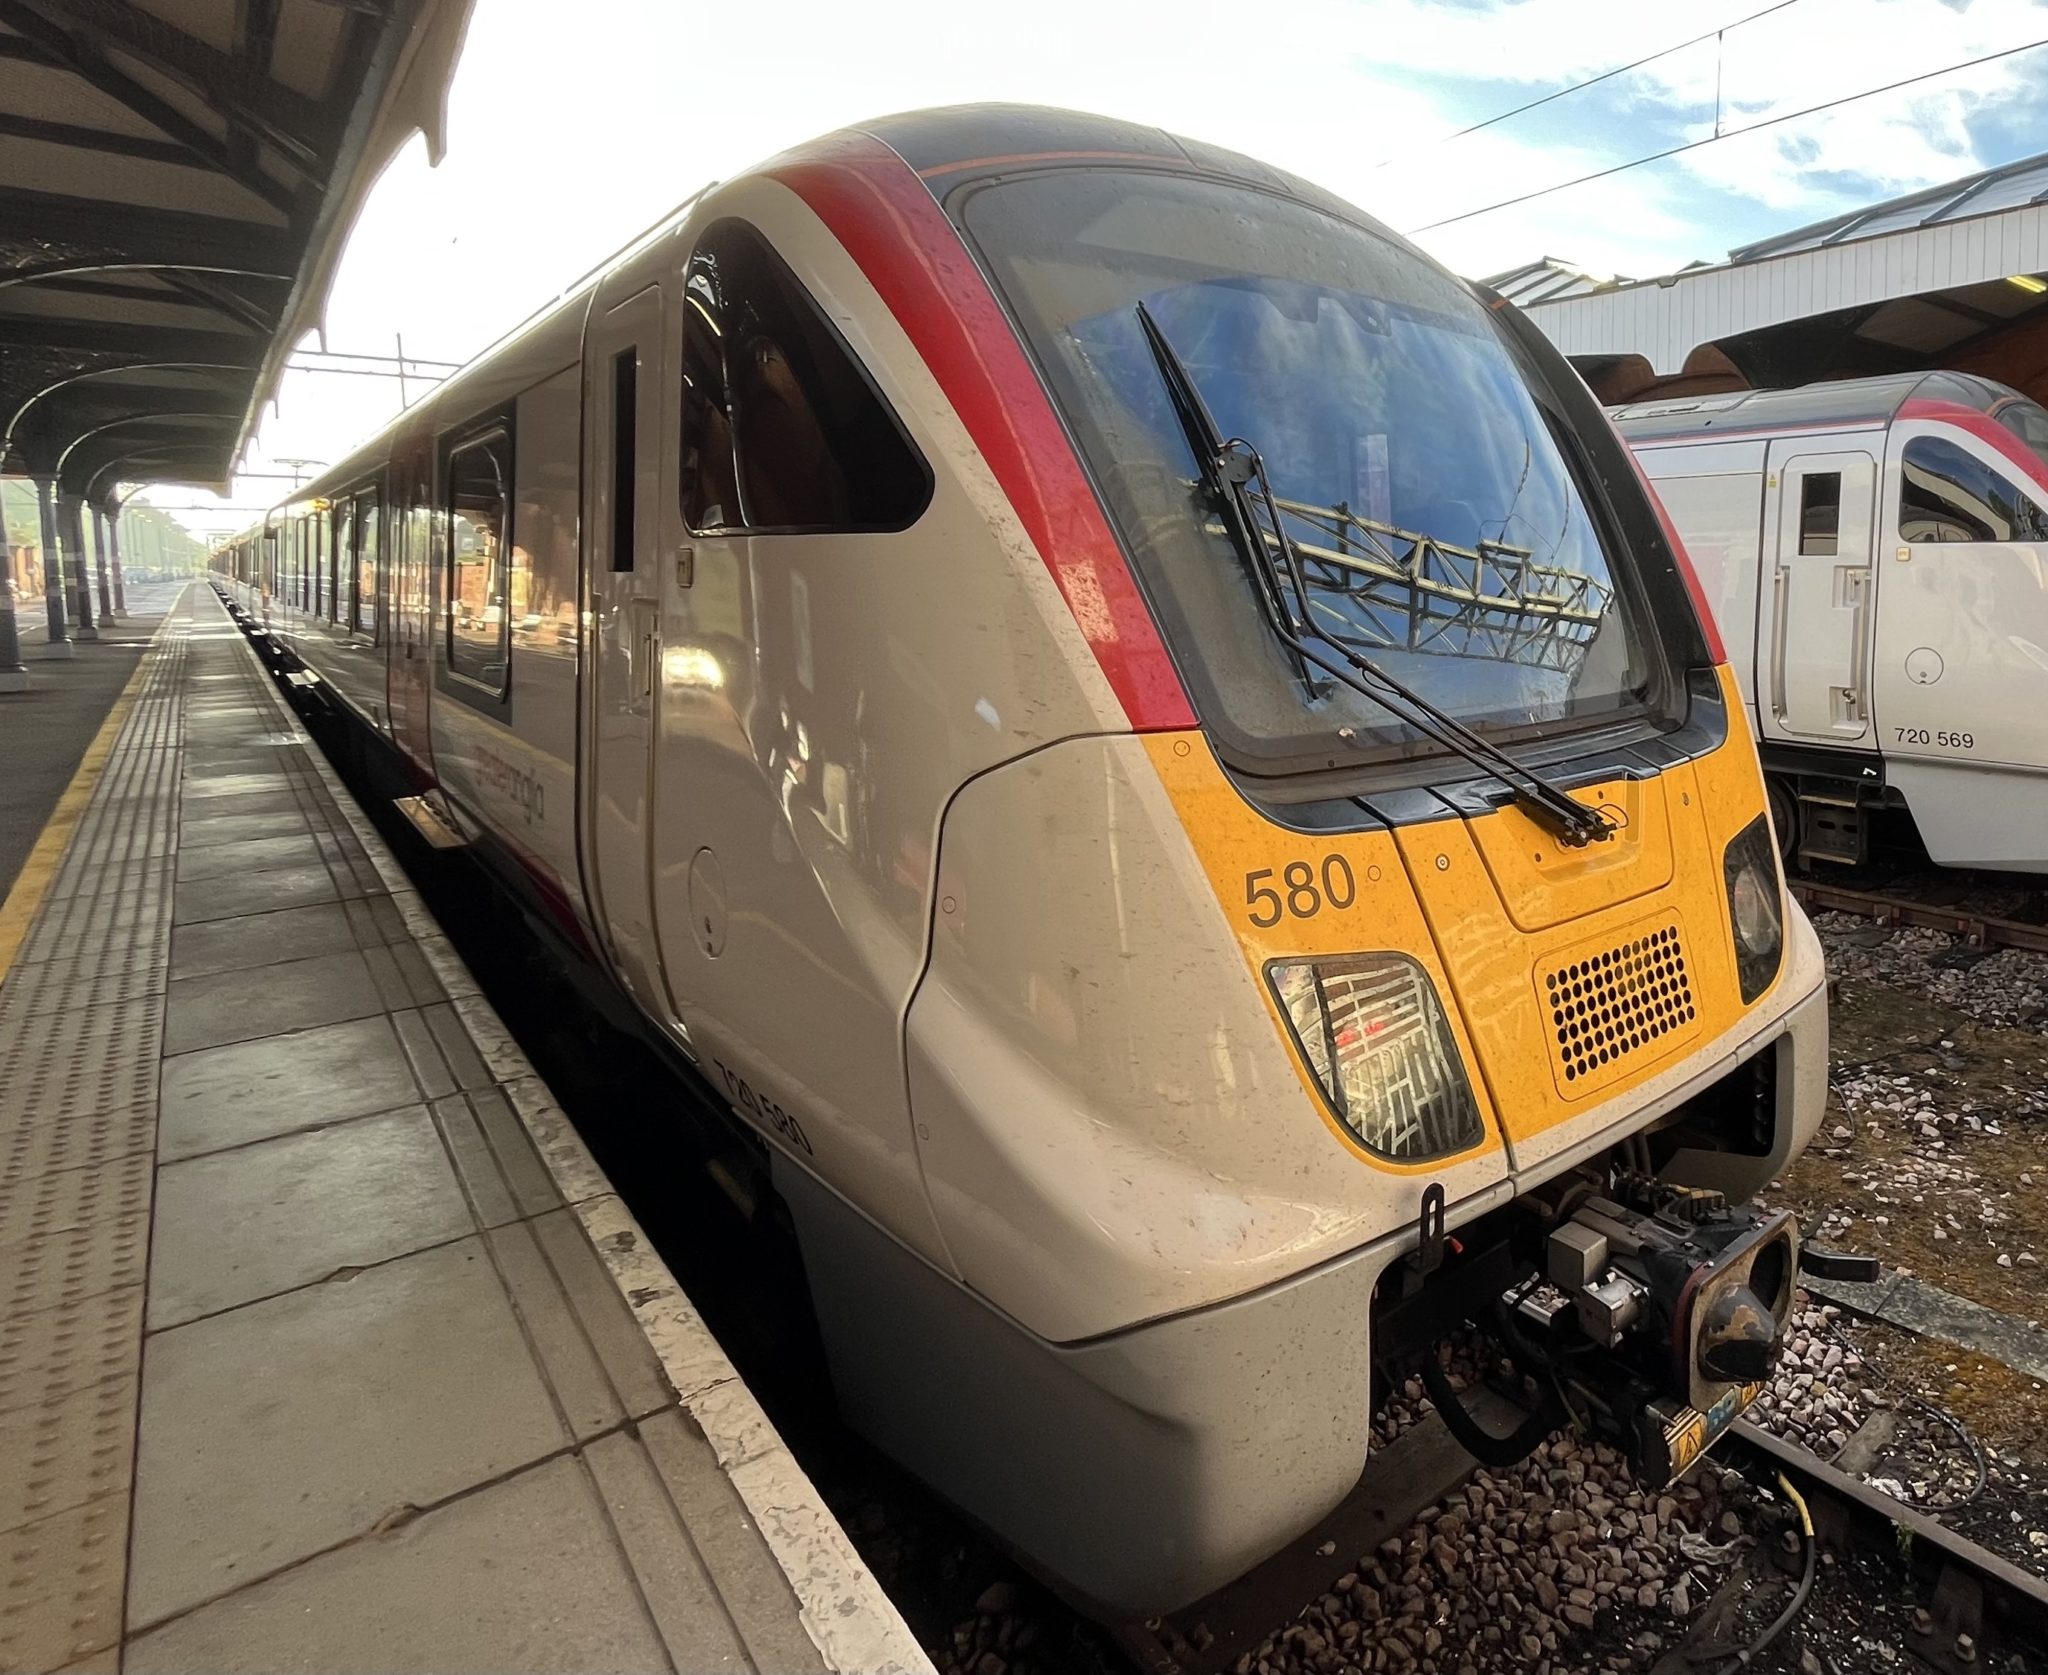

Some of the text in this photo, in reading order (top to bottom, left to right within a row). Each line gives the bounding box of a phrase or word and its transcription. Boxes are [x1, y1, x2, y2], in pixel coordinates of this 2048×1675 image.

[1894, 727, 1975, 749] 720 569
[1246, 853, 1356, 928] 580
[713, 1058, 814, 1156] 720 580
